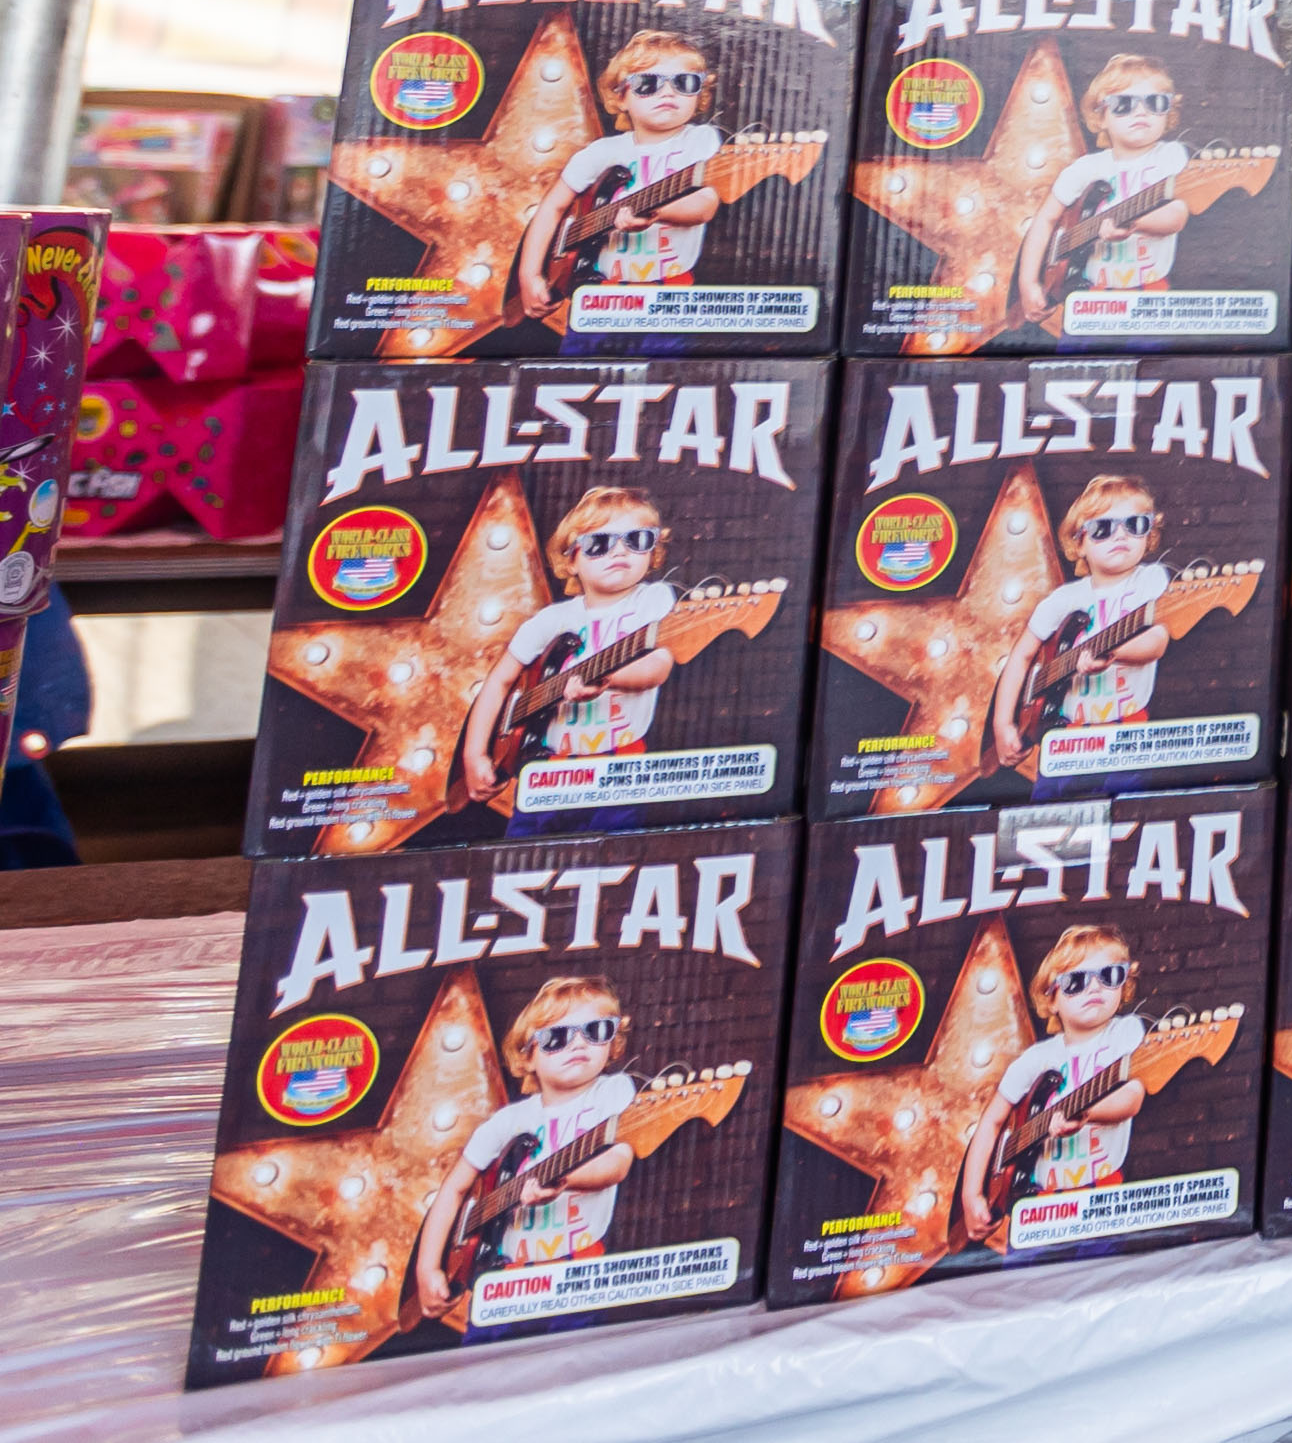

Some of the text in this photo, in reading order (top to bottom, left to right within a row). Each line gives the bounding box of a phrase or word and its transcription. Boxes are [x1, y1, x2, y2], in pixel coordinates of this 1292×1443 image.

[27, 244, 82, 274] Never
[366, 278, 454, 291] PERFORMANCE
[581, 295, 645, 310] CAUTION
[656, 292, 689, 302] EMITS
[692, 292, 745, 303] SHOWERS
[760, 293, 802, 303] SPARKS
[1073, 300, 1127, 314] CAUTION
[648, 304, 680, 315] SPINS
[700, 304, 744, 315] GROUND
[746, 305, 808, 315] FLAMMABLE
[1116, 729, 1145, 742] EMITS
[1147, 725, 1195, 739] SHOWERS
[1208, 721, 1245, 734] SPARKS
[858, 734, 936, 753] PERFORMANCE
[1049, 735, 1106, 755] CAUTION
[1108, 741, 1137, 754] SPINS
[1154, 737, 1194, 751] GROUND
[1195, 732, 1251, 747] FLAMMABLE
[607, 761, 641, 775] EMITS
[645, 756, 700, 772] SHOWERS
[716, 752, 760, 767] SPARKS
[303, 765, 395, 786] PERFORMANCE
[528, 768, 595, 789] CAUTION
[598, 774, 632, 788] SPINS
[652, 769, 699, 784] GROUND
[701, 765, 766, 781] FLAMMABLE
[1089, 1191, 1119, 1207] EMITS
[1122, 1183, 1172, 1202] SHOWERS
[1185, 1176, 1224, 1193] SPARKS
[1019, 1201, 1079, 1225] CAUTION
[1082, 1205, 1111, 1221] SPINS
[1129, 1197, 1170, 1214] GROUND
[1172, 1188, 1230, 1208] FLAMMABLE
[821, 1210, 902, 1236] PERFORMANCE
[565, 1263, 600, 1280] EMITS
[603, 1254, 661, 1275] SHOWERS
[677, 1246, 723, 1264] SPARKS
[483, 1274, 552, 1301] CAUTION
[556, 1278, 590, 1295] SPINS
[611, 1268, 659, 1287] GROUND
[661, 1258, 729, 1280] FLAMMABLE
[250, 1286, 345, 1315] PERFORMANCE
